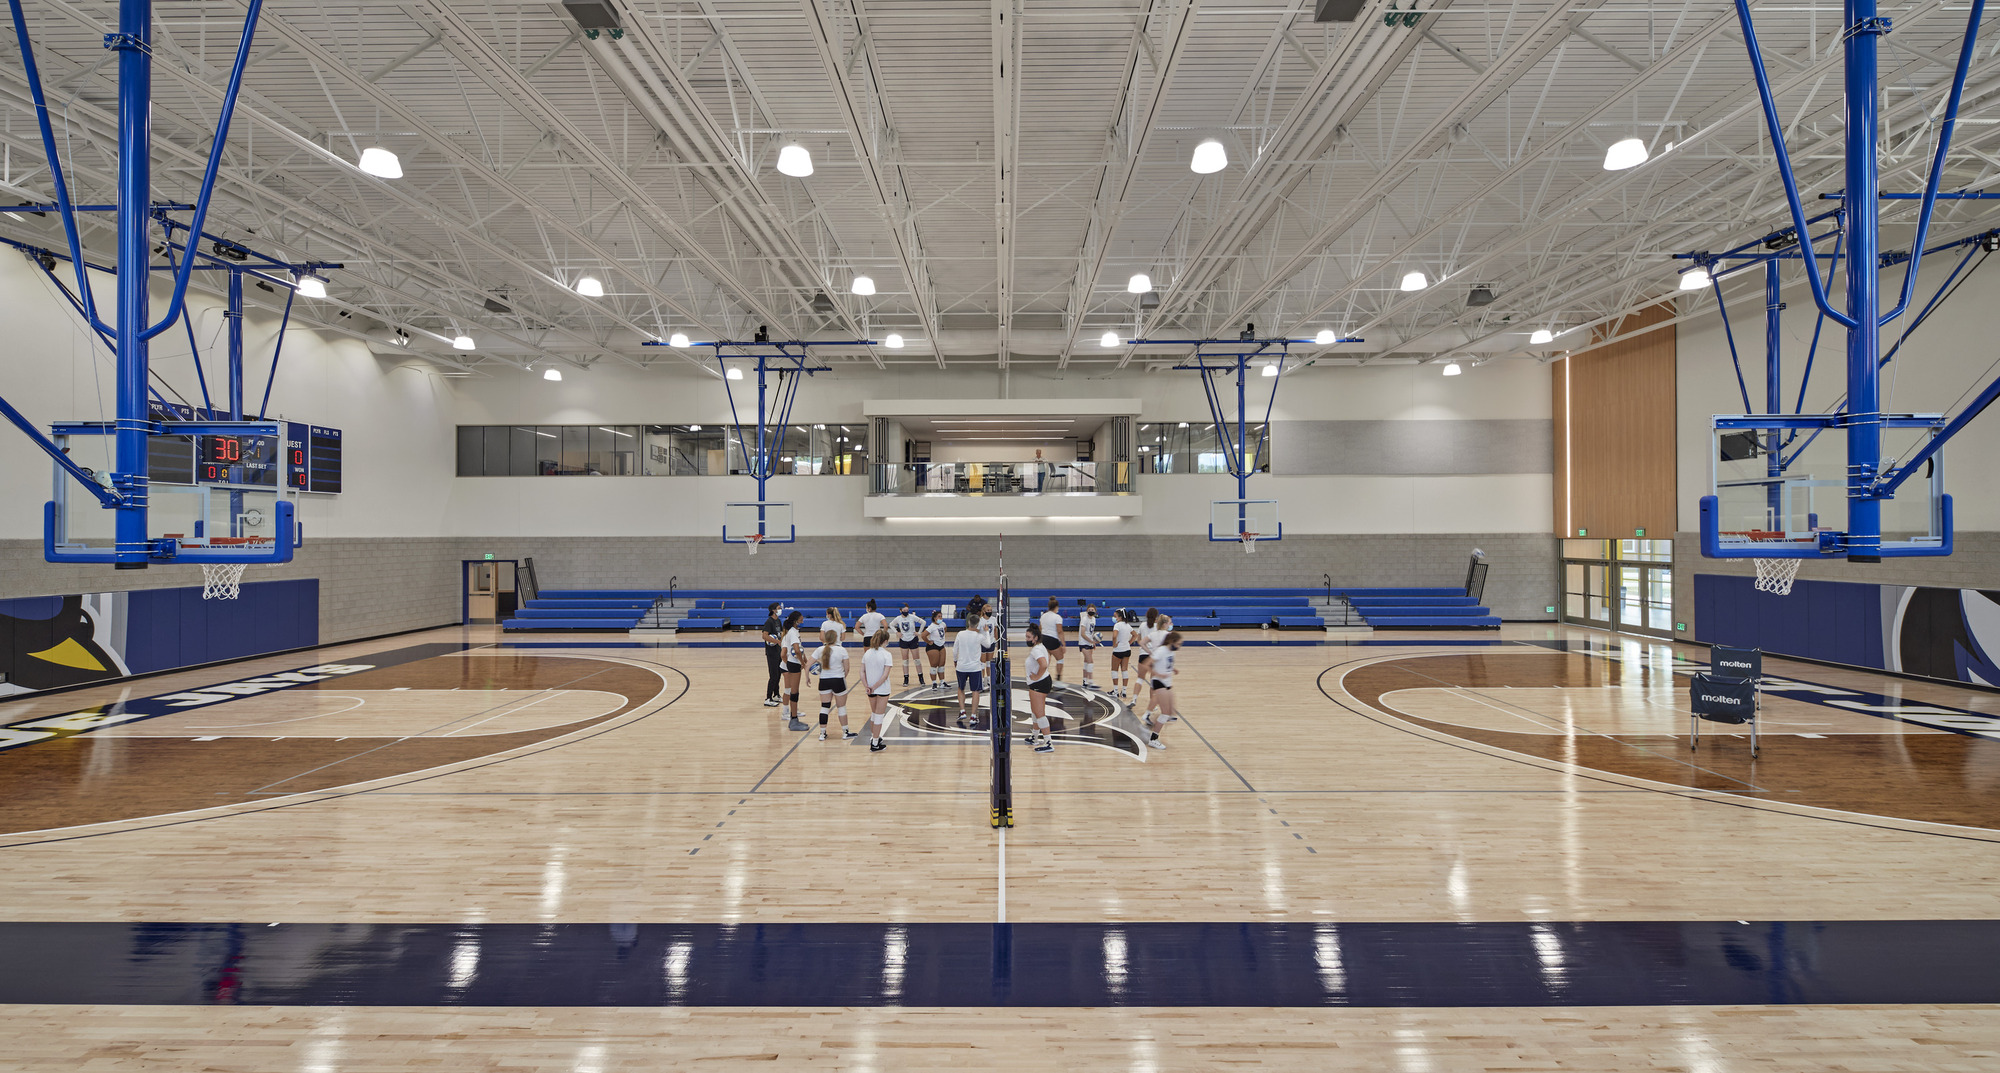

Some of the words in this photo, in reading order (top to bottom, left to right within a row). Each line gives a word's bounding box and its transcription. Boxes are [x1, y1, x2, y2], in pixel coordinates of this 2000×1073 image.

[181, 407, 190, 415] PTS
[216, 438, 239, 461] 30
[287, 440, 303, 449] UEST
[294, 450, 303, 465] 0
[208, 466, 216, 479] 0
[221, 468, 228, 478] 0
[299, 473, 306, 485] 0
[1720, 660, 1752, 669] molten
[151, 664, 376, 708] JAYS
[1701, 694, 1741, 705] molten
